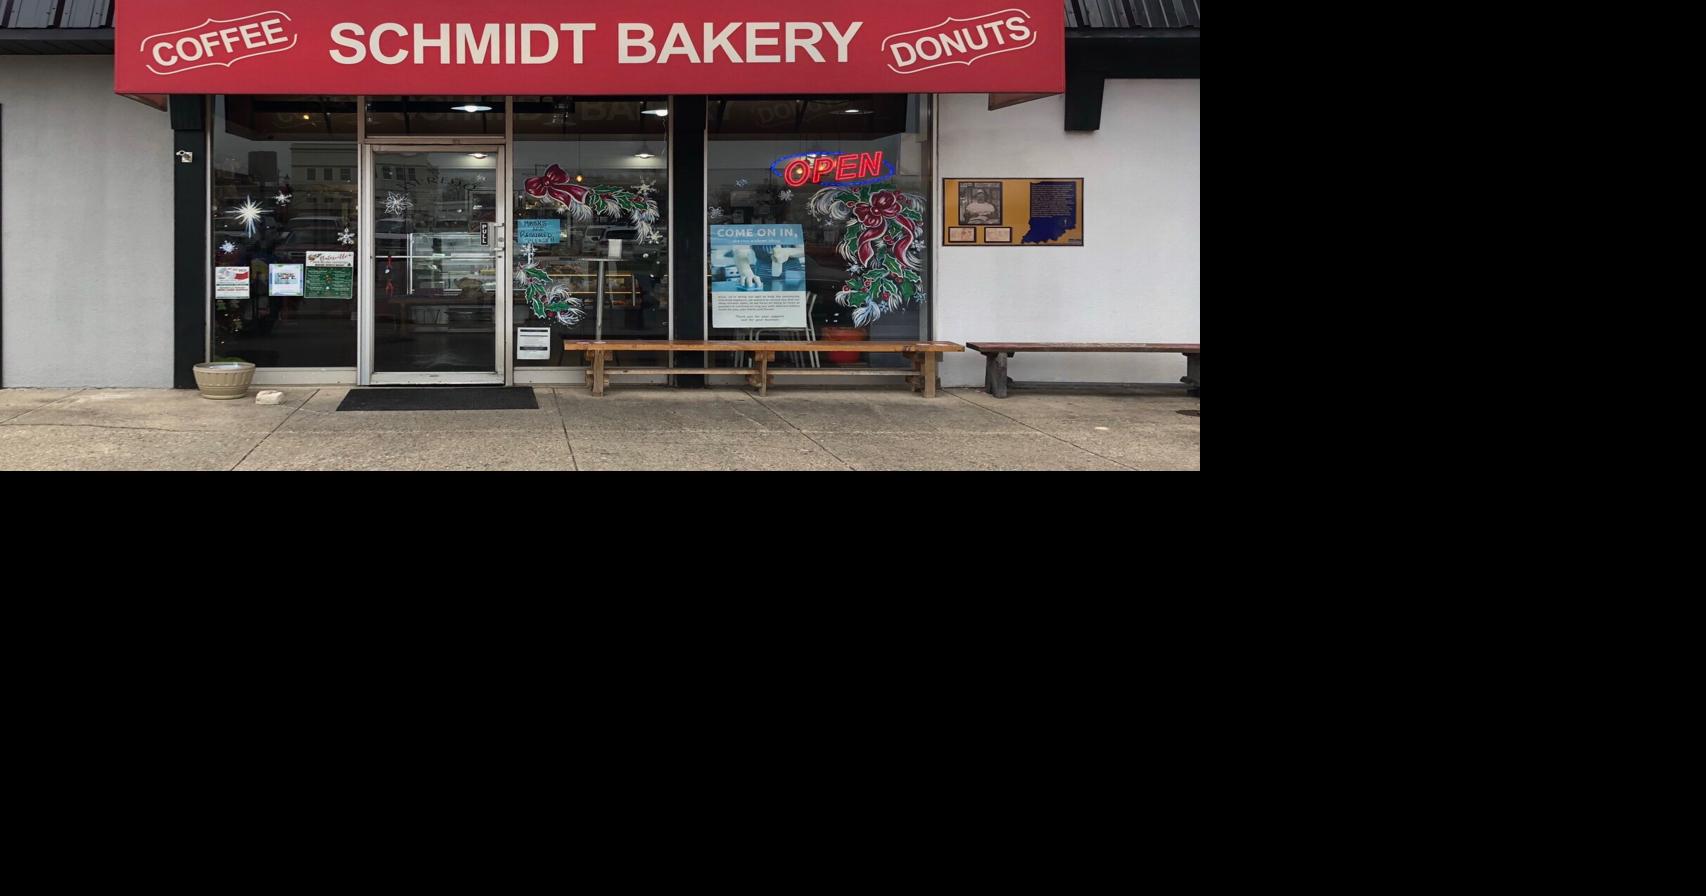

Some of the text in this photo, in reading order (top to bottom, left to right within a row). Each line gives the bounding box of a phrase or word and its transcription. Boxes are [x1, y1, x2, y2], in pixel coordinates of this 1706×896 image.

[153, 19, 288, 66] COFFEE
[329, 21, 863, 65] SCHMIDT BAKERY
[890, 17, 1030, 67] DONUTS
[784, 151, 883, 187] OPEN
[717, 229, 753, 237] COME
[757, 228, 776, 237] ON
